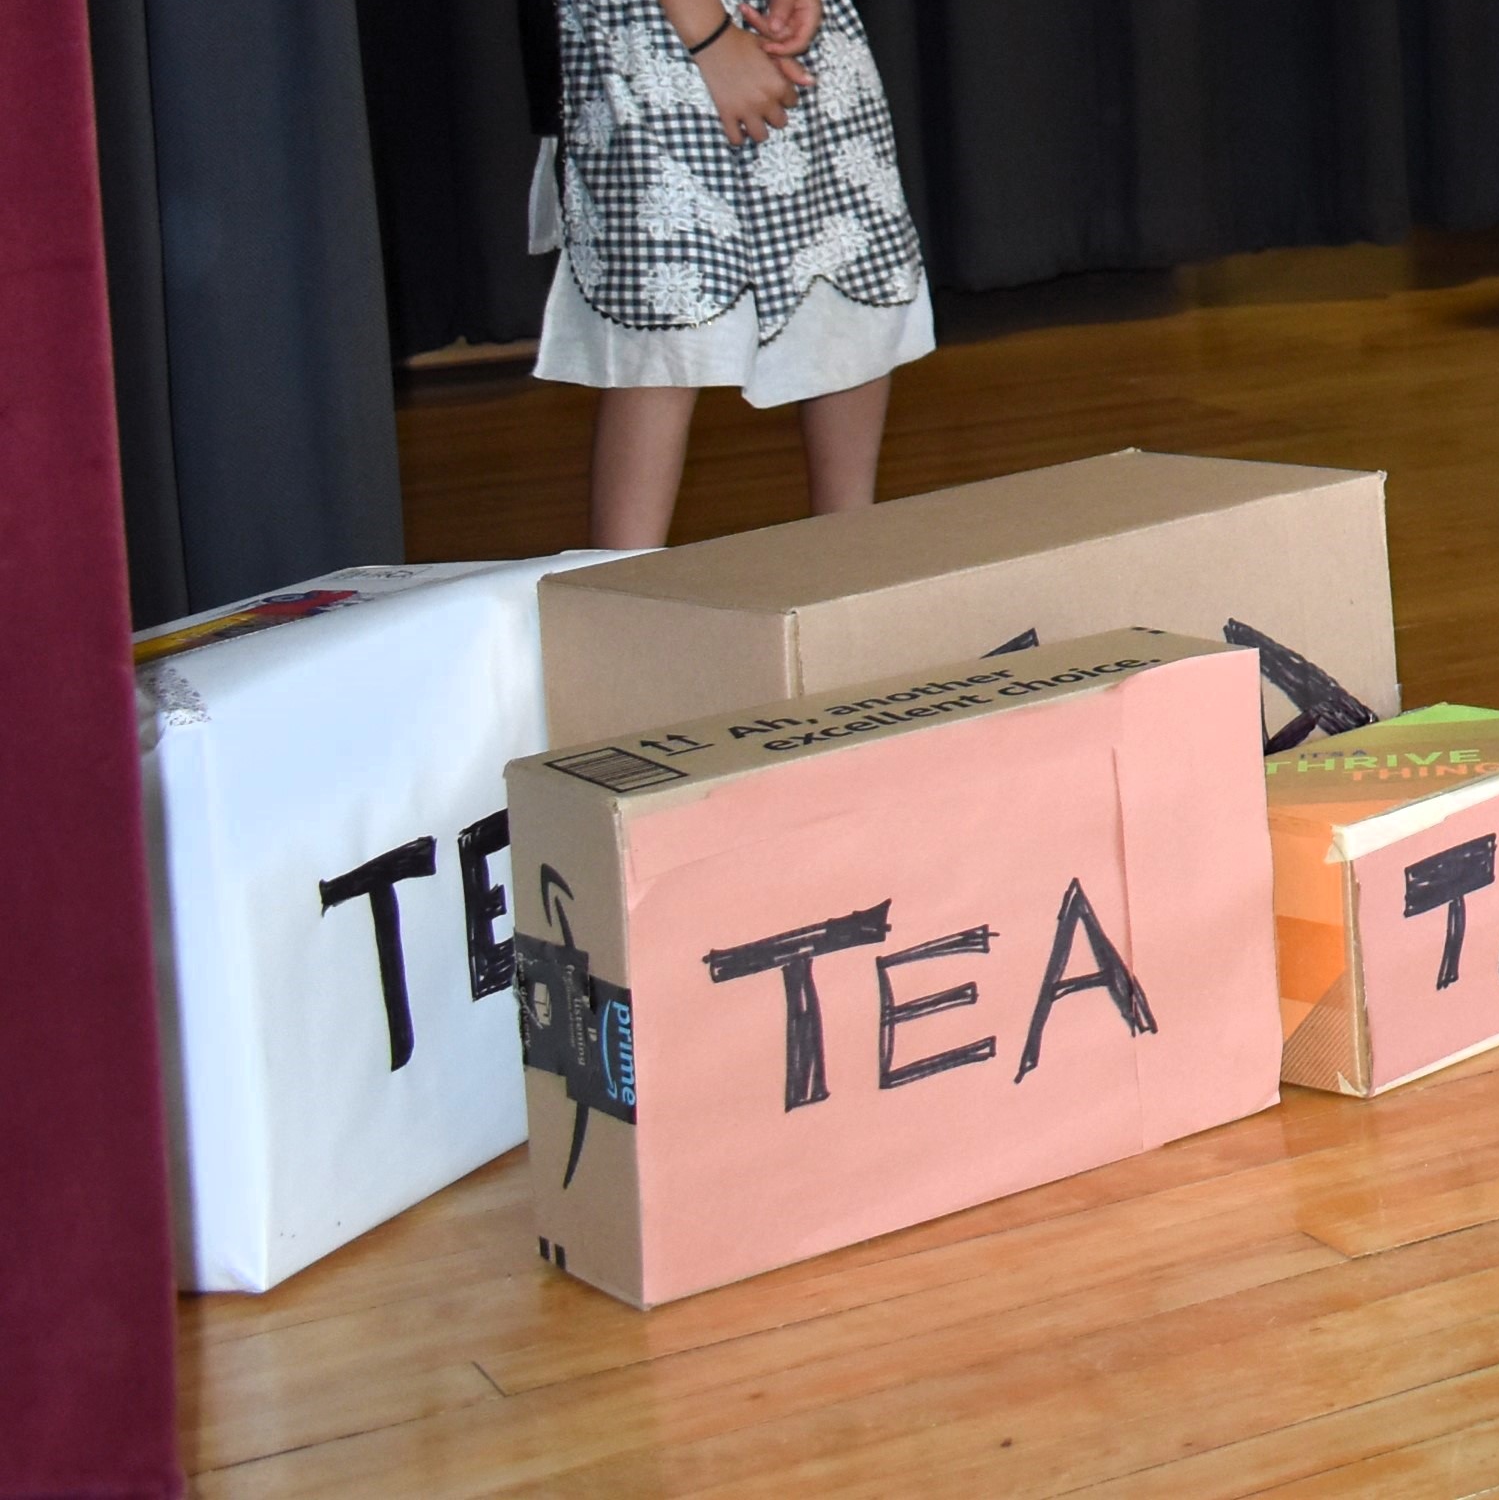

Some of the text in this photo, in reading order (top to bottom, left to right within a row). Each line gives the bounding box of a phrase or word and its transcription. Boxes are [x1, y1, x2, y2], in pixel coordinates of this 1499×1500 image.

[727, 668, 1015, 740] Ah, another
[763, 654, 1163, 753] excellent choice.
[1266, 749, 1481, 775] THRIVE
[613, 1001, 637, 1106] prime
[701, 897, 1159, 1113] TEA
